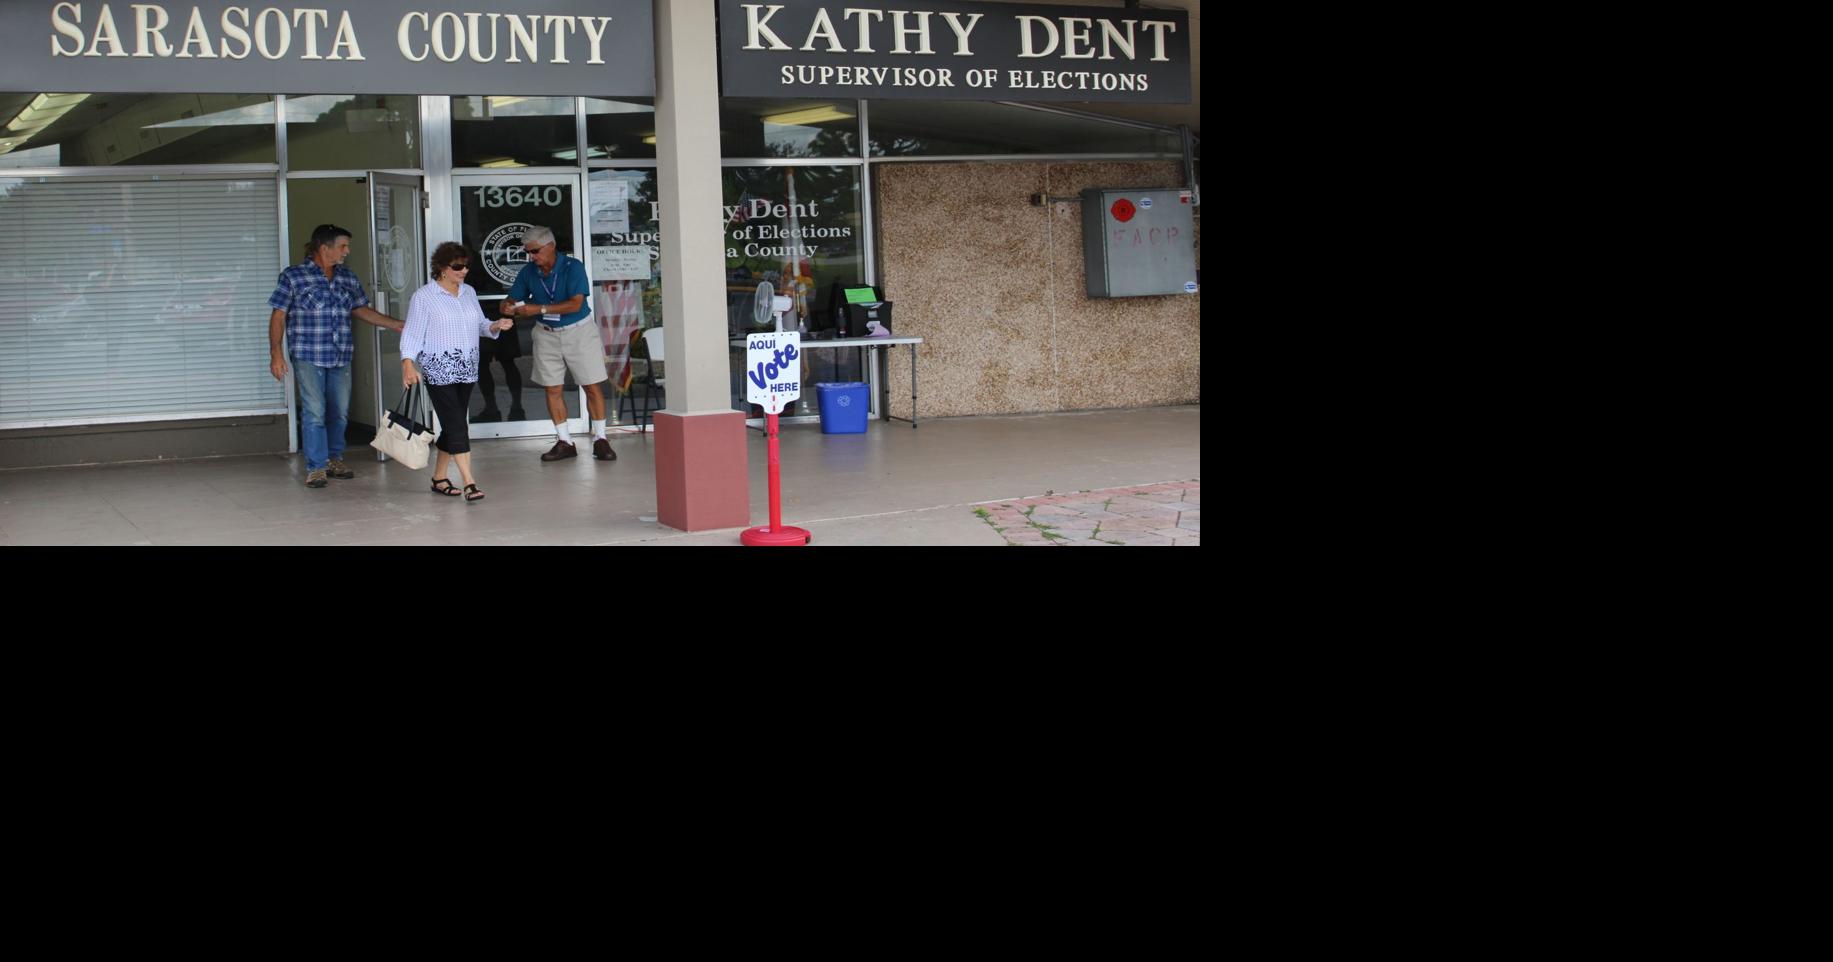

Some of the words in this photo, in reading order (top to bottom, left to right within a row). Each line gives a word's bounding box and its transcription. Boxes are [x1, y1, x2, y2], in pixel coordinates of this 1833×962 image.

[51, 2, 366, 60] SARASOTA
[397, 11, 613, 65] COUNTY
[741, 3, 985, 57] KATHY
[1015, 14, 1177, 62] DENT
[781, 64, 955, 88] SUPERVISOR
[966, 68, 998, 88] OF
[1008, 70, 1149, 92] ELECTIONS
[474, 186, 563, 208] 13640
[749, 198, 819, 219] Dent
[489, 229, 506, 245] STATE
[732, 225, 753, 240] of
[757, 222, 852, 239] Elections
[744, 243, 818, 258] County
[486, 259, 508, 281] COUNTY
[749, 339, 776, 350] AQUI
[748, 344, 798, 389] Vote
[770, 382, 798, 392] HERE
